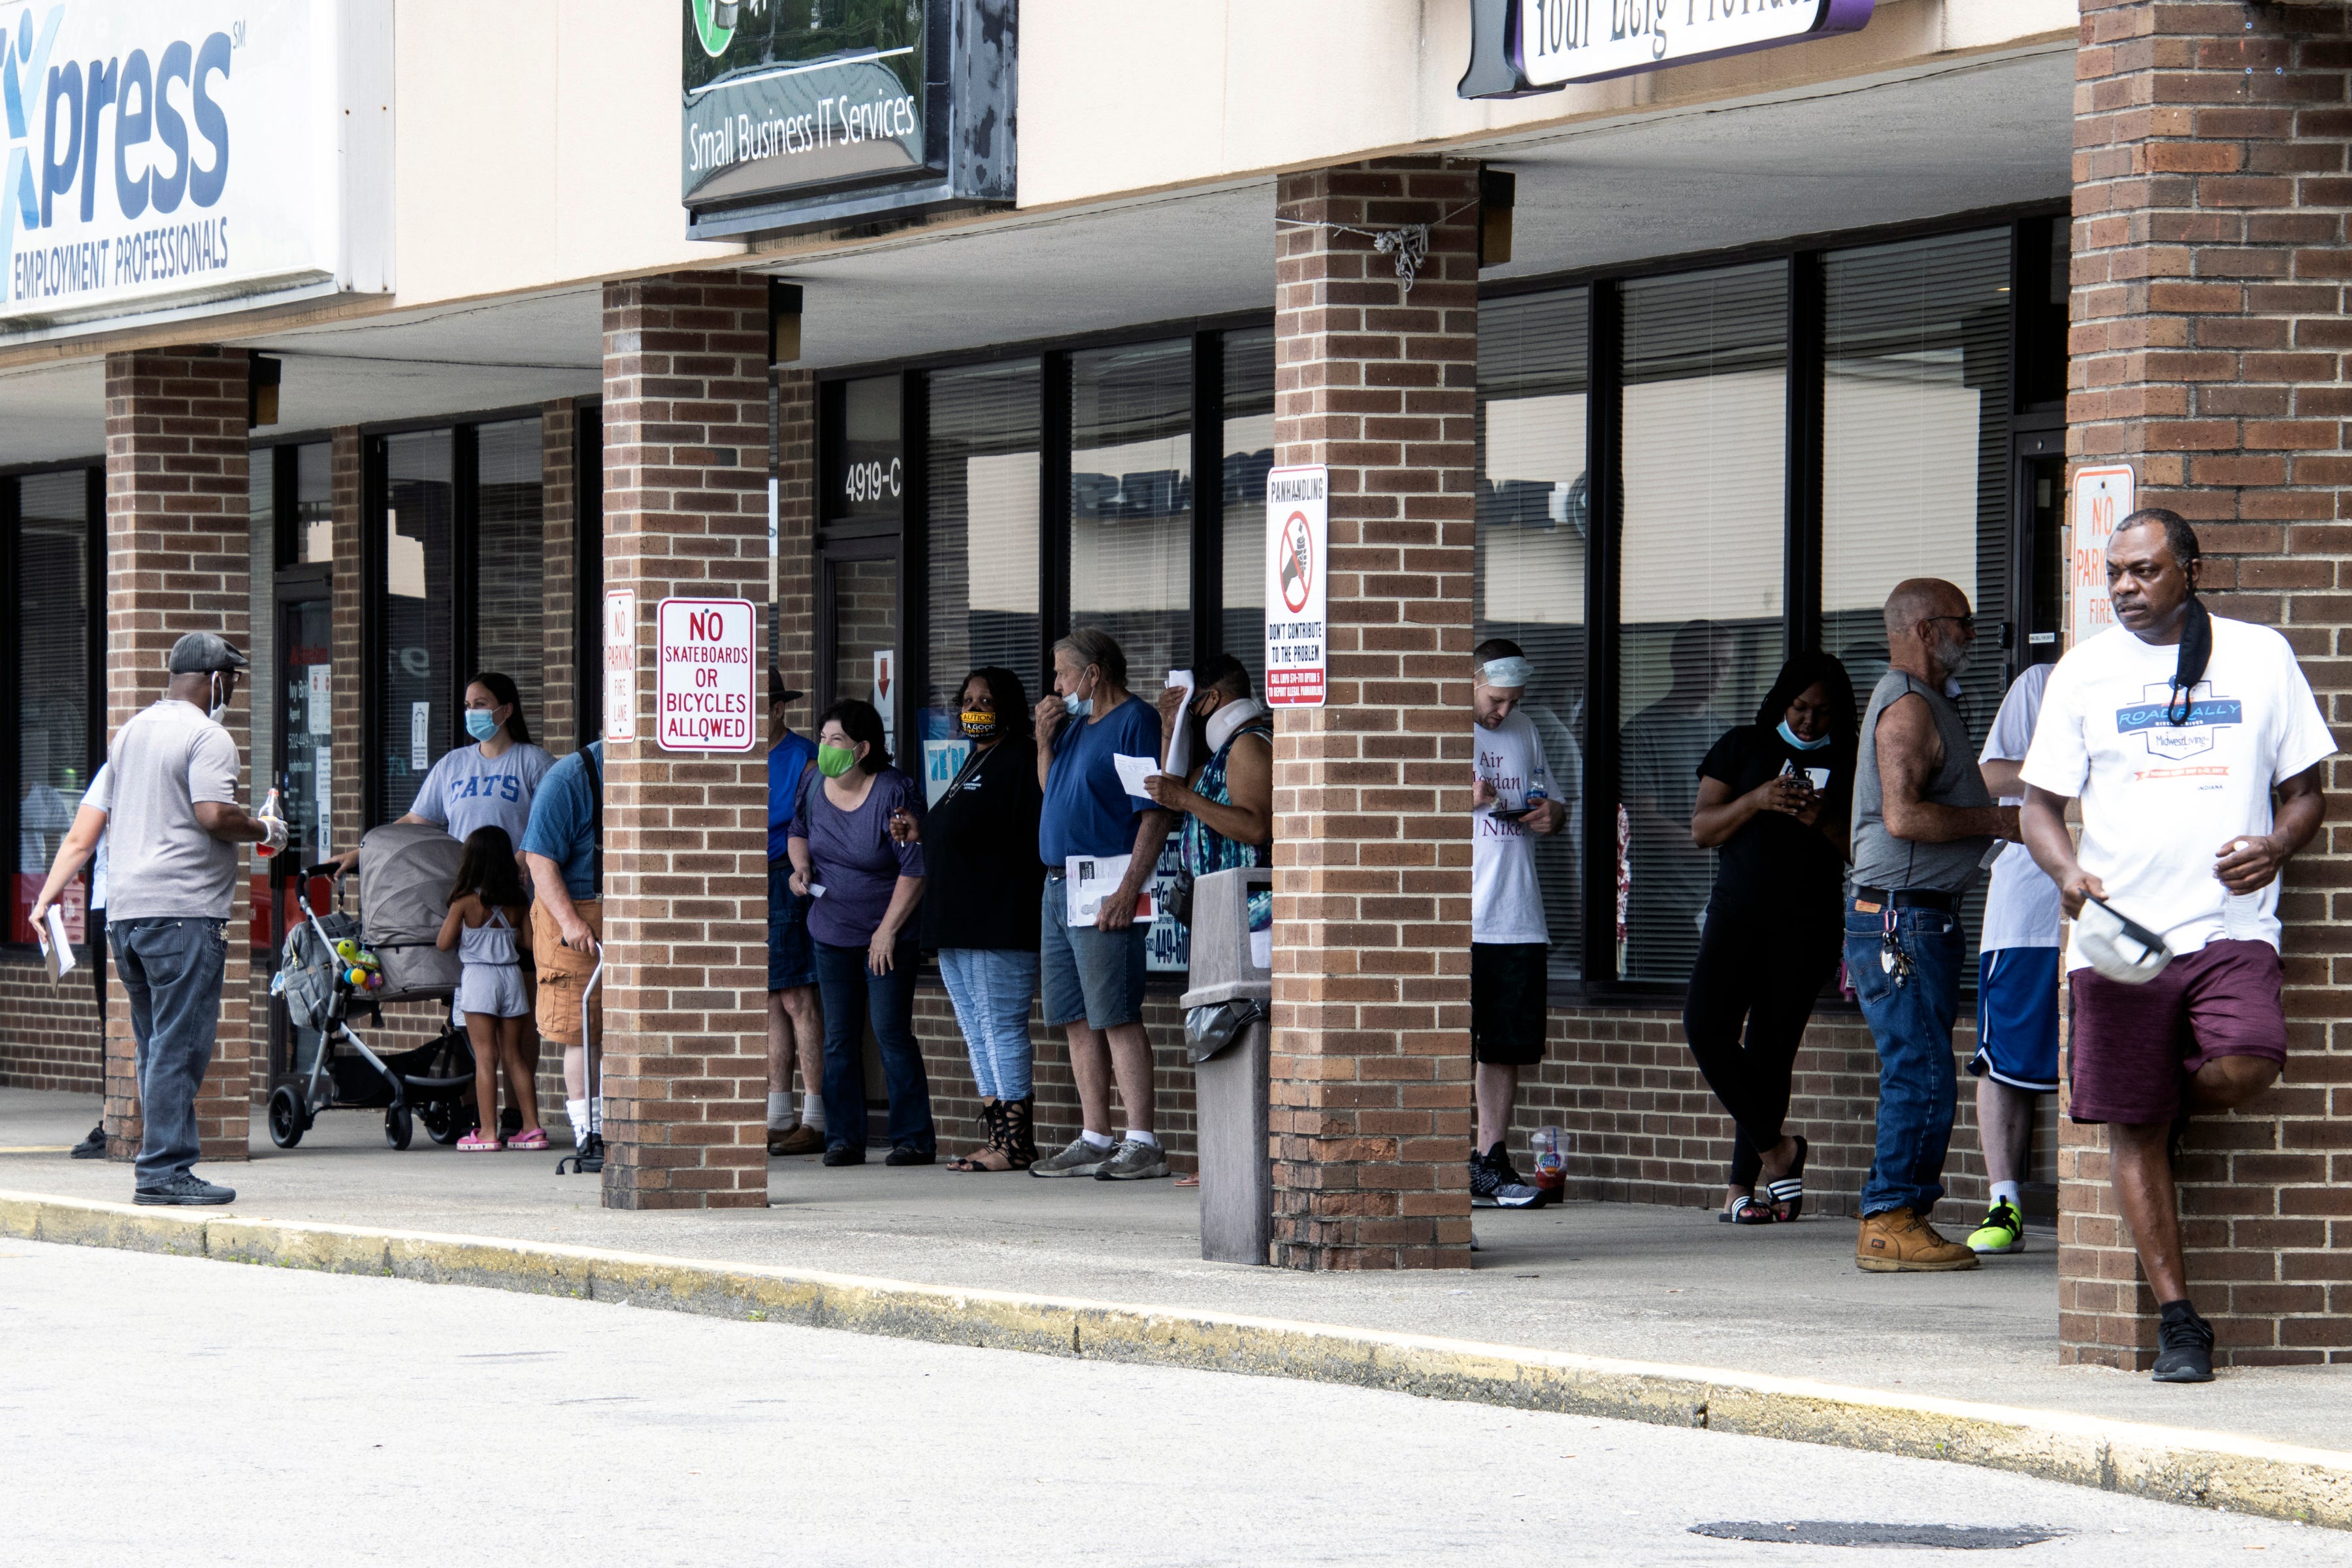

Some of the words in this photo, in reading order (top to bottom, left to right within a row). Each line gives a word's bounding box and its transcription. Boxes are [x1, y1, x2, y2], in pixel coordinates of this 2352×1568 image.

[233, 20, 246, 50] SM
[689, 116, 733, 171] Small
[739, 108, 812, 162] Business
[818, 98, 834, 148] IT
[839, 89, 915, 145] Services
[15, 239, 109, 300] EMPLOYMENT
[115, 216, 228, 286] PROFESSIONALS
[845, 457, 900, 502] 4919-C
[1271, 477, 1323, 504] PANHANDLING
[2092, 496, 2114, 536] NO
[2076, 548, 2106, 587] PARK
[2090, 598, 2113, 624] FIRE
[615, 611, 625, 638] NO
[690, 612, 724, 642] NO
[1269, 623, 1286, 640] DON'T
[1288, 622, 1322, 640] CONTRIBUTE
[608, 644, 632, 672] PARKING
[665, 645, 748, 664] SKATEBOARDS
[1272, 646, 1279, 662] TO
[1281, 645, 1291, 662] THE
[1294, 644, 1320, 662] PROBLEM
[614, 679, 627, 697] FIRE
[696, 668, 718, 688] OR
[1269, 687, 1273, 697] TO
[1273, 687, 1286, 697] REPORT
[1287, 686, 1299, 696] ILLEGAL
[1300, 685, 1323, 696] PANHANDLING
[614, 704, 627, 723] LANE
[666, 693, 746, 713] BICYCLES
[668, 717, 745, 738] ALLOWED
[1479, 751, 1503, 768] Air
[450, 774, 520, 806] CATS
[1482, 819, 1526, 837] Nike.
